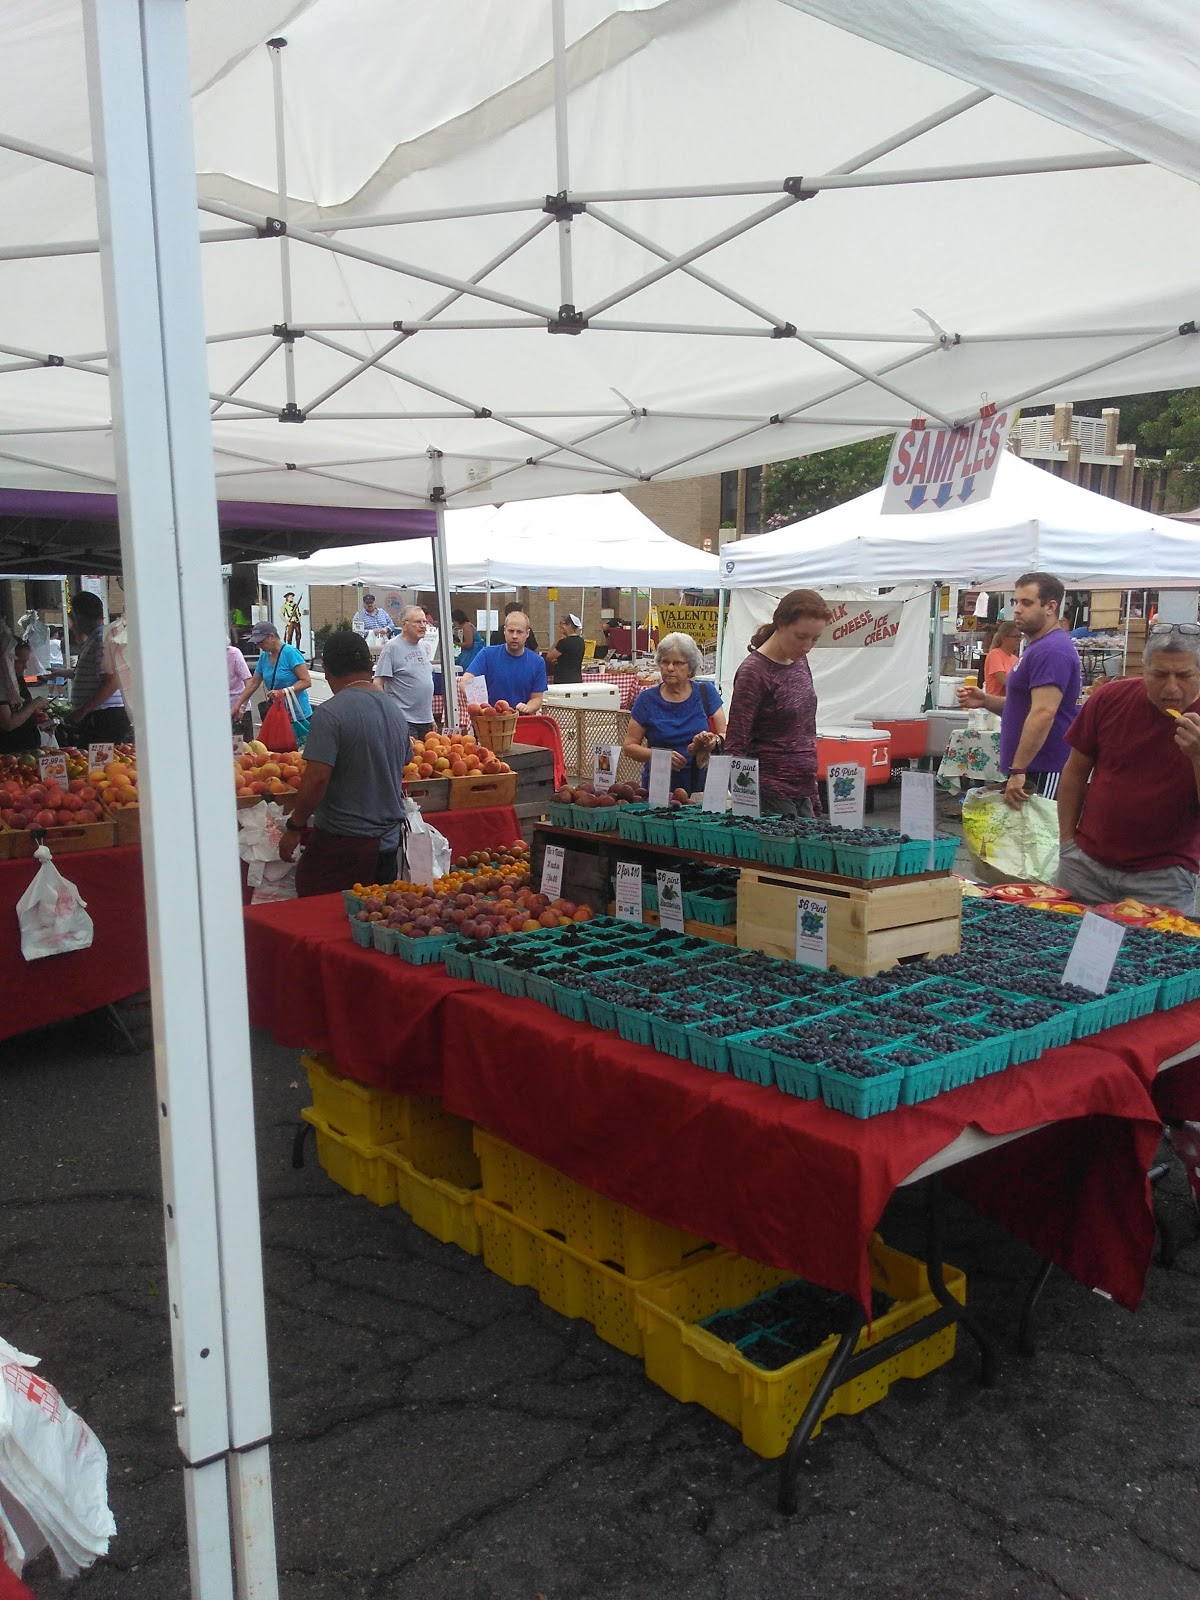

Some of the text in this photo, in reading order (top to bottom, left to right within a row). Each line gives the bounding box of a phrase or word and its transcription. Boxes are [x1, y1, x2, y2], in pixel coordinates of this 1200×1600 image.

[892, 412, 1008, 486] SAMPLES
[666, 622, 697, 630] BAKERY
[832, 609, 874, 641] CHEESE
[873, 613, 889, 631] ICE
[41, 757, 59, 766] $2.99
[731, 760, 741, 769] $6
[829, 767, 858, 778] $6 Pint
[616, 864, 621, 875] 2
[657, 872, 680, 885] $6 pint
[798, 899, 828, 914] $6 Pint
